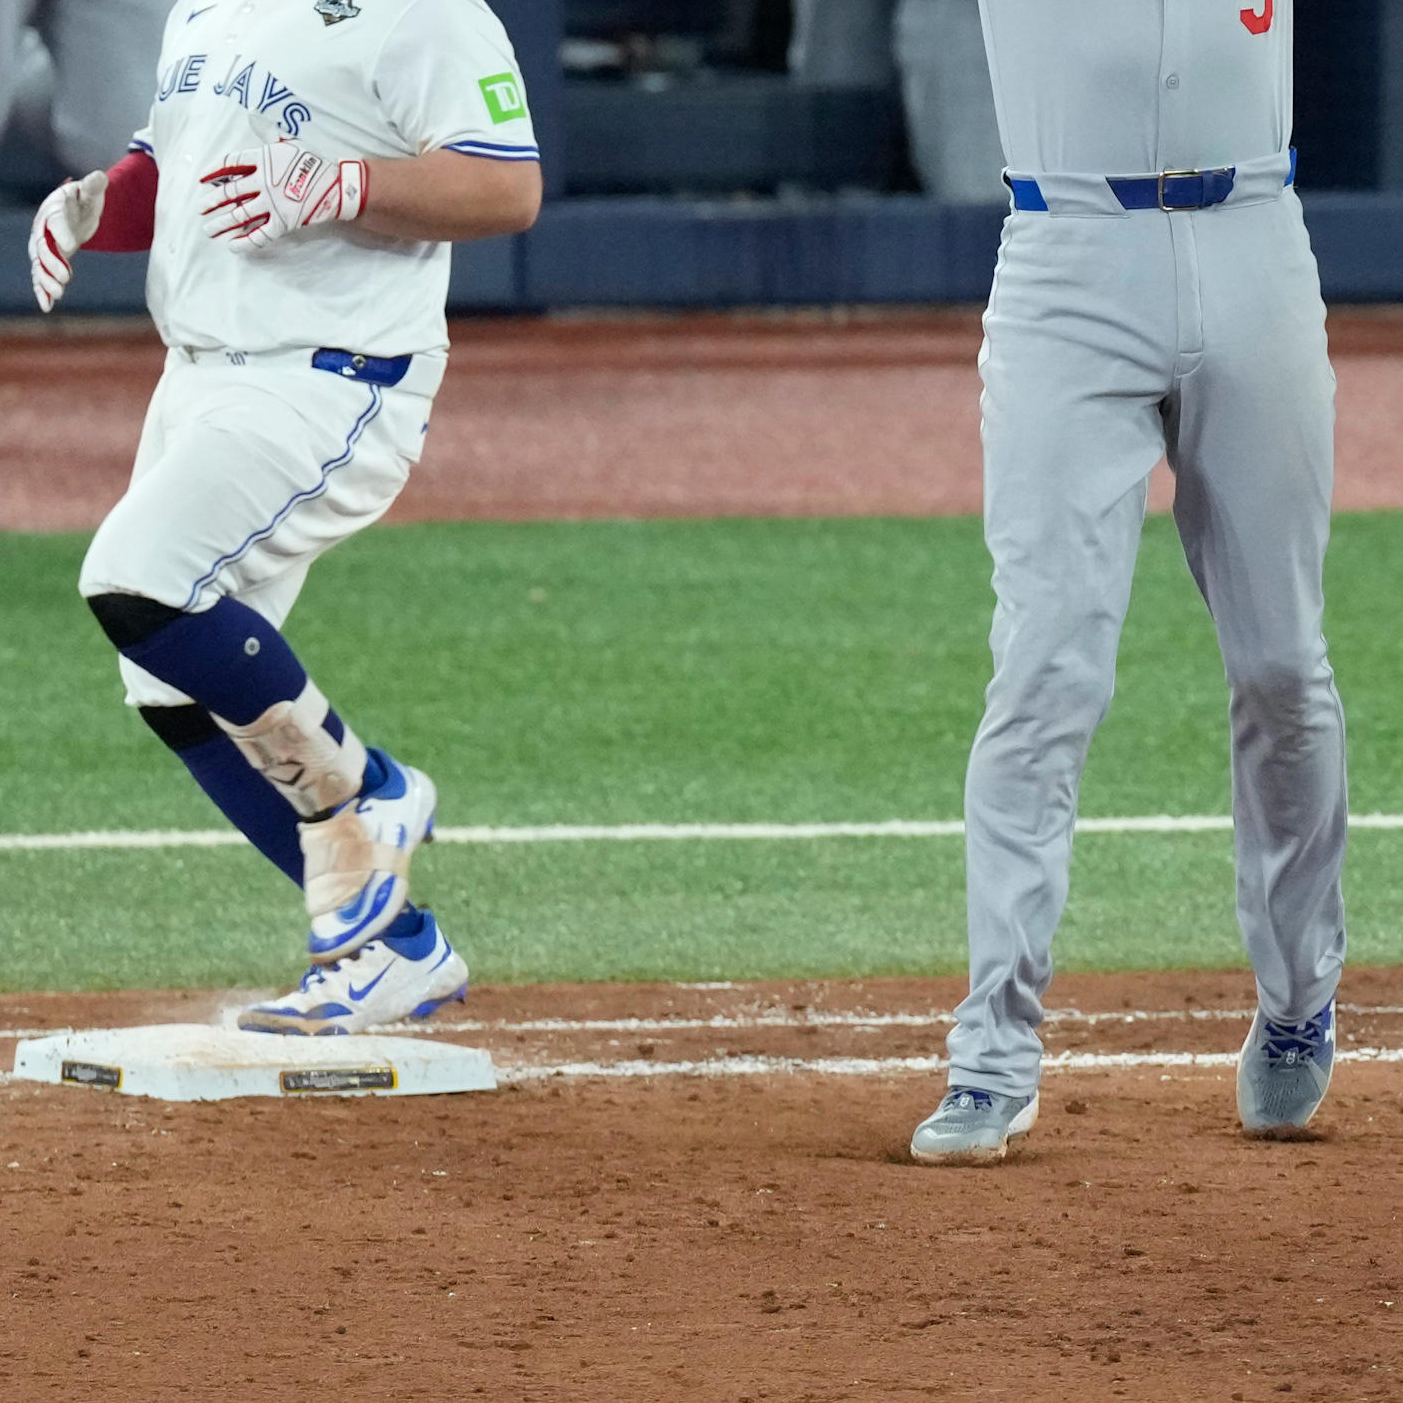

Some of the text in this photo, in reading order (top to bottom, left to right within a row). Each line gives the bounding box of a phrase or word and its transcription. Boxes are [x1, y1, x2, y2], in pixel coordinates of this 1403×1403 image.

[213, 54, 311, 137] JAYS
[485, 81, 521, 112] TD
[288, 157, 318, 199] Franklin
